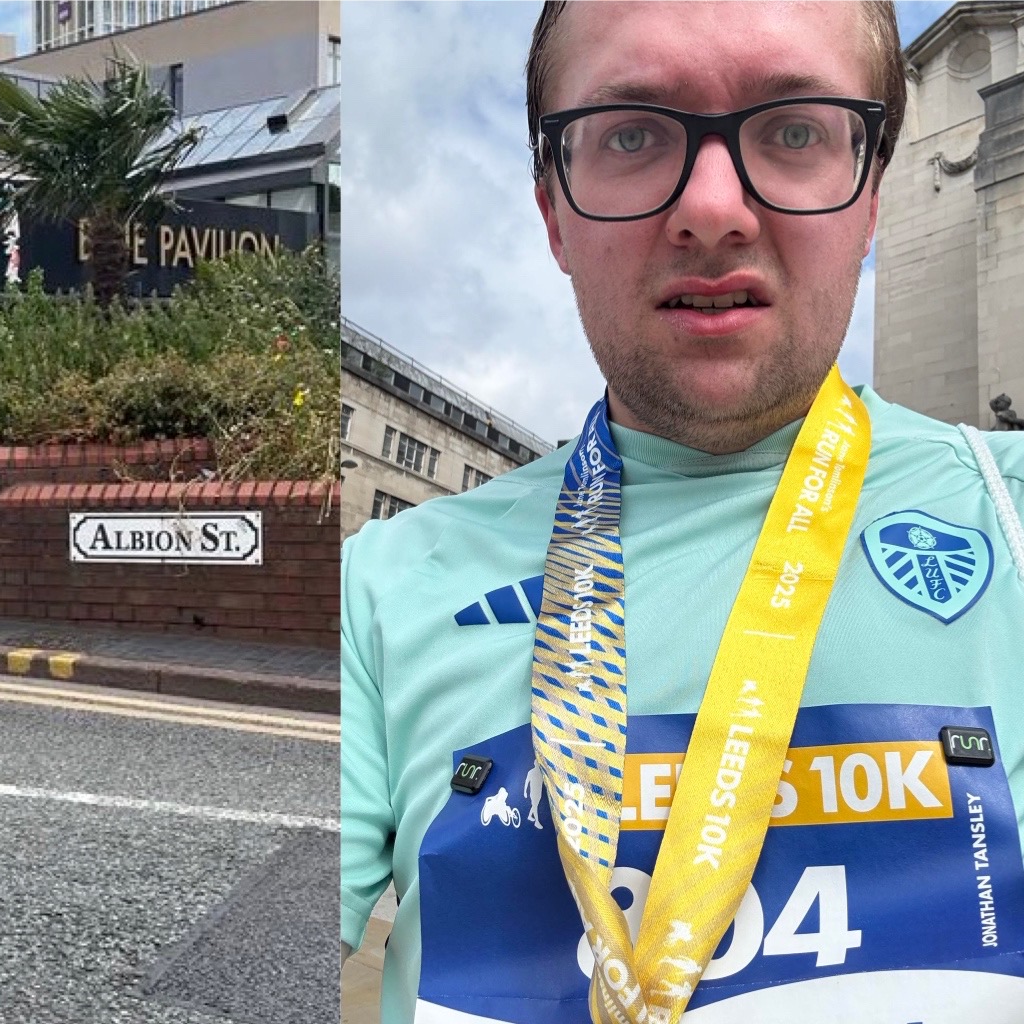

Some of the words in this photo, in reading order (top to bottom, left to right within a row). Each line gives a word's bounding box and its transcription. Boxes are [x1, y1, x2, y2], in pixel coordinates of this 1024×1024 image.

[160, 224, 280, 269] PAVILION
[586, 432, 606, 476] FOR
[812, 427, 841, 469] RUN
[837, 440, 852, 462] Jane
[586, 472, 607, 505] RUN
[794, 466, 828, 504] FOR
[820, 463, 846, 513] Tomlinson's
[89, 522, 194, 552] ALBION
[200, 522, 241, 552] ST.
[786, 503, 814, 534] ALL
[573, 563, 594, 601] 10K
[770, 559, 804, 609] 2025
[569, 601, 594, 654] LEEDS
[709, 723, 754, 810] LEEDS
[808, 750, 944, 814] 10K
[564, 783, 585, 853] 2025
[693, 812, 732, 871] 10K
[966, 792, 990, 871] TANSLEY
[976, 875, 998, 948] JONATHAN
